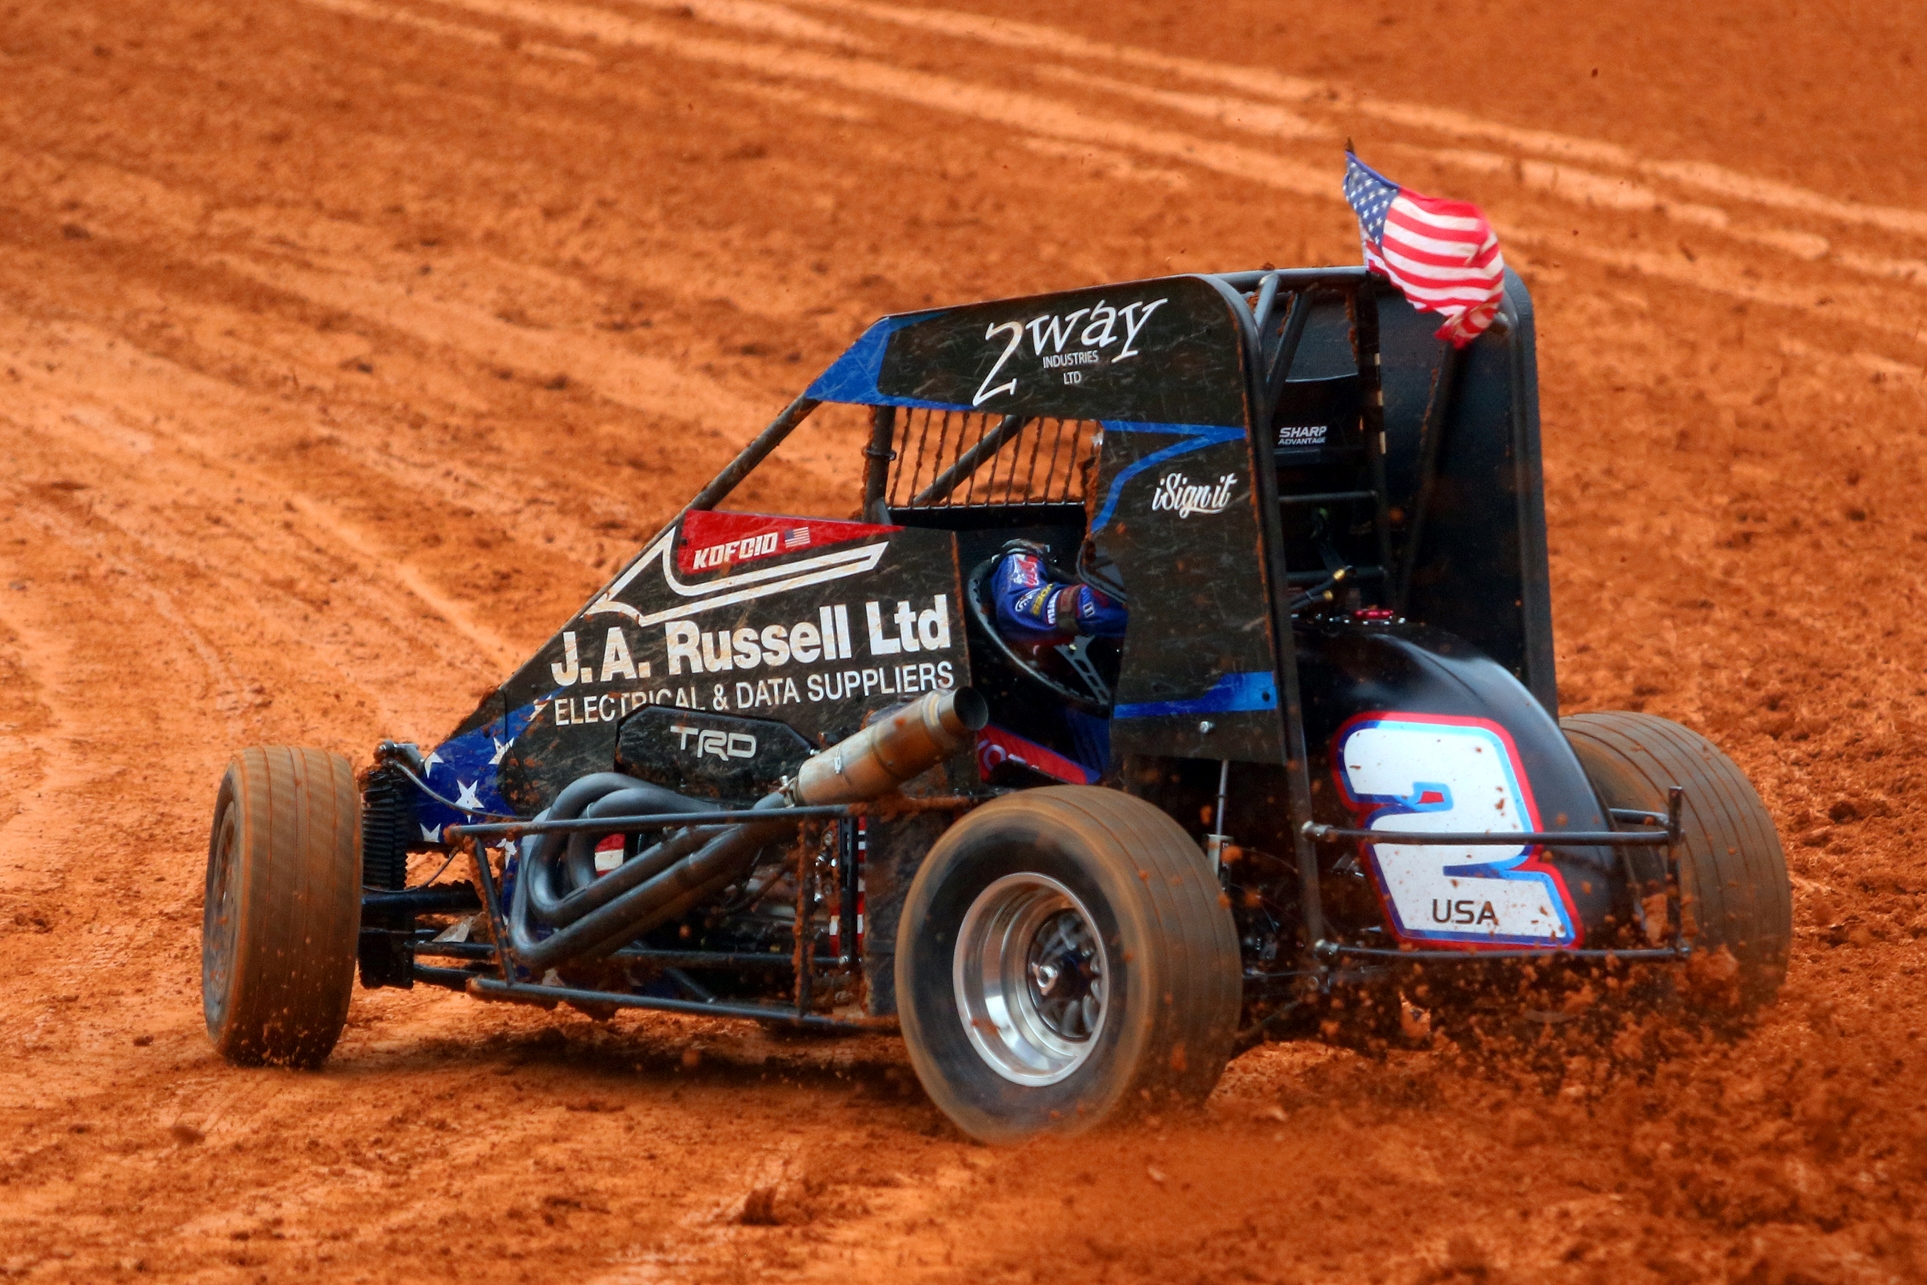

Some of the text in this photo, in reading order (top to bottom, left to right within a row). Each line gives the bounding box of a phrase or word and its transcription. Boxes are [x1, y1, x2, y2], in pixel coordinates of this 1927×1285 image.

[1042, 349, 1099, 369] INDUSTRIES
[1063, 370, 1083, 385] LTD
[1277, 436, 1326, 445] ADVANTAGE
[1279, 425, 1328, 438] SHARP
[664, 603, 852, 676] Russell
[865, 593, 951, 656] Ltd
[712, 683, 730, 711] &
[735, 676, 801, 710] DATA
[806, 660, 954, 702] SUPPLIERS
[669, 725, 757, 762] TRD
[1335, 715, 1579, 947] 2
[1431, 898, 1500, 926] USA
